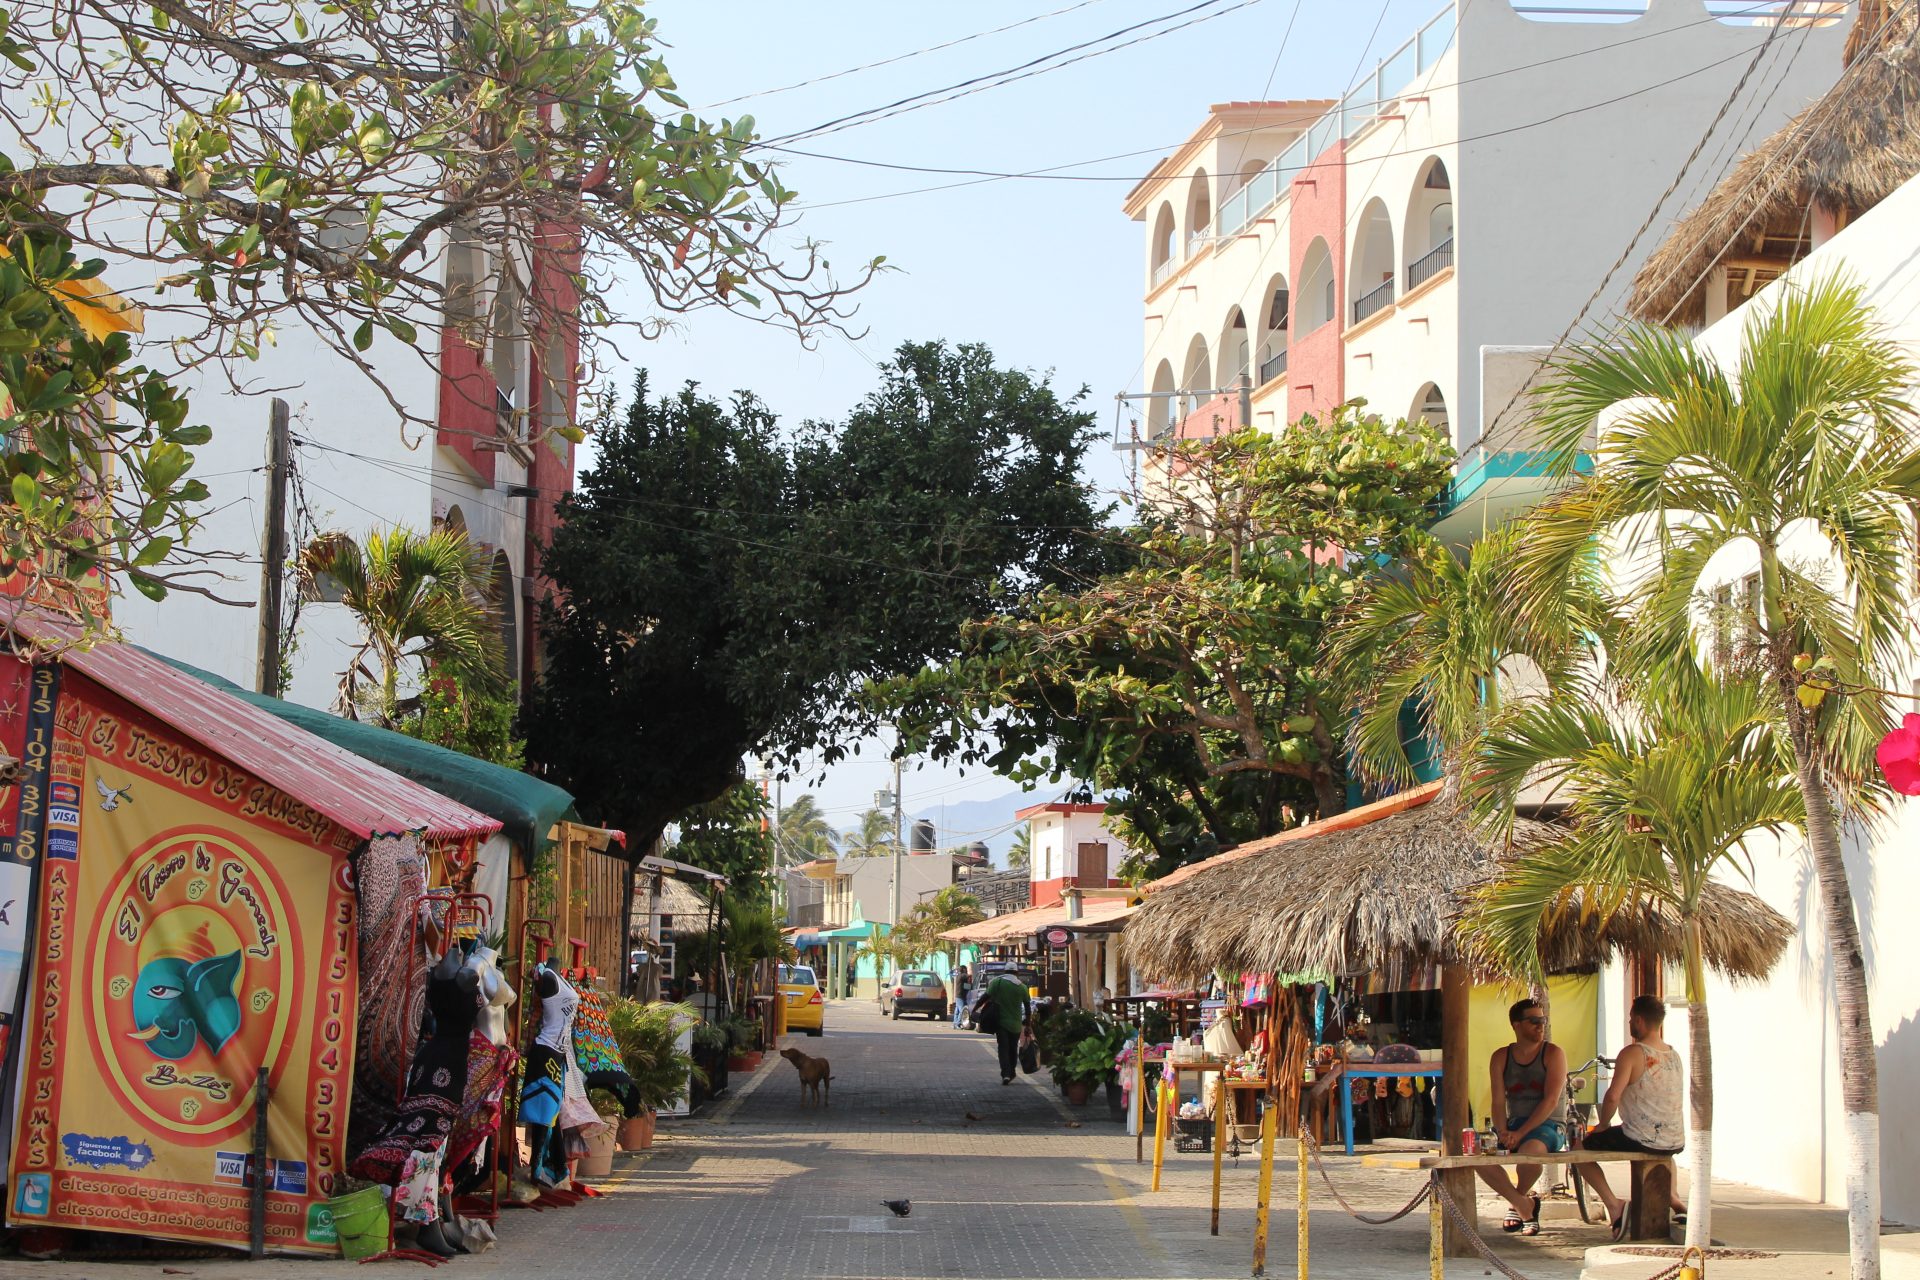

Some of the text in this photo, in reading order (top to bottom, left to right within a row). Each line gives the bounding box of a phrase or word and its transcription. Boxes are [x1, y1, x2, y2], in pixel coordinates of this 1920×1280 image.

[53, 810, 78, 823] VISA
[127, 729, 208, 786] TESORO
[214, 767, 244, 800] DE
[243, 786, 330, 843] GANESH
[48, 868, 67, 960] ARTES
[120, 845, 276, 957] El Tesoro de Ganesh
[40, 973, 59, 1067] ROPAS
[316, 901, 353, 1197] 315 104 32 50
[30, 1110, 49, 1166] MAS
[78, 1147, 122, 1159] facebook
[220, 1161, 241, 1175] VISA
[309, 1228, 338, 1238] WhatsApp
